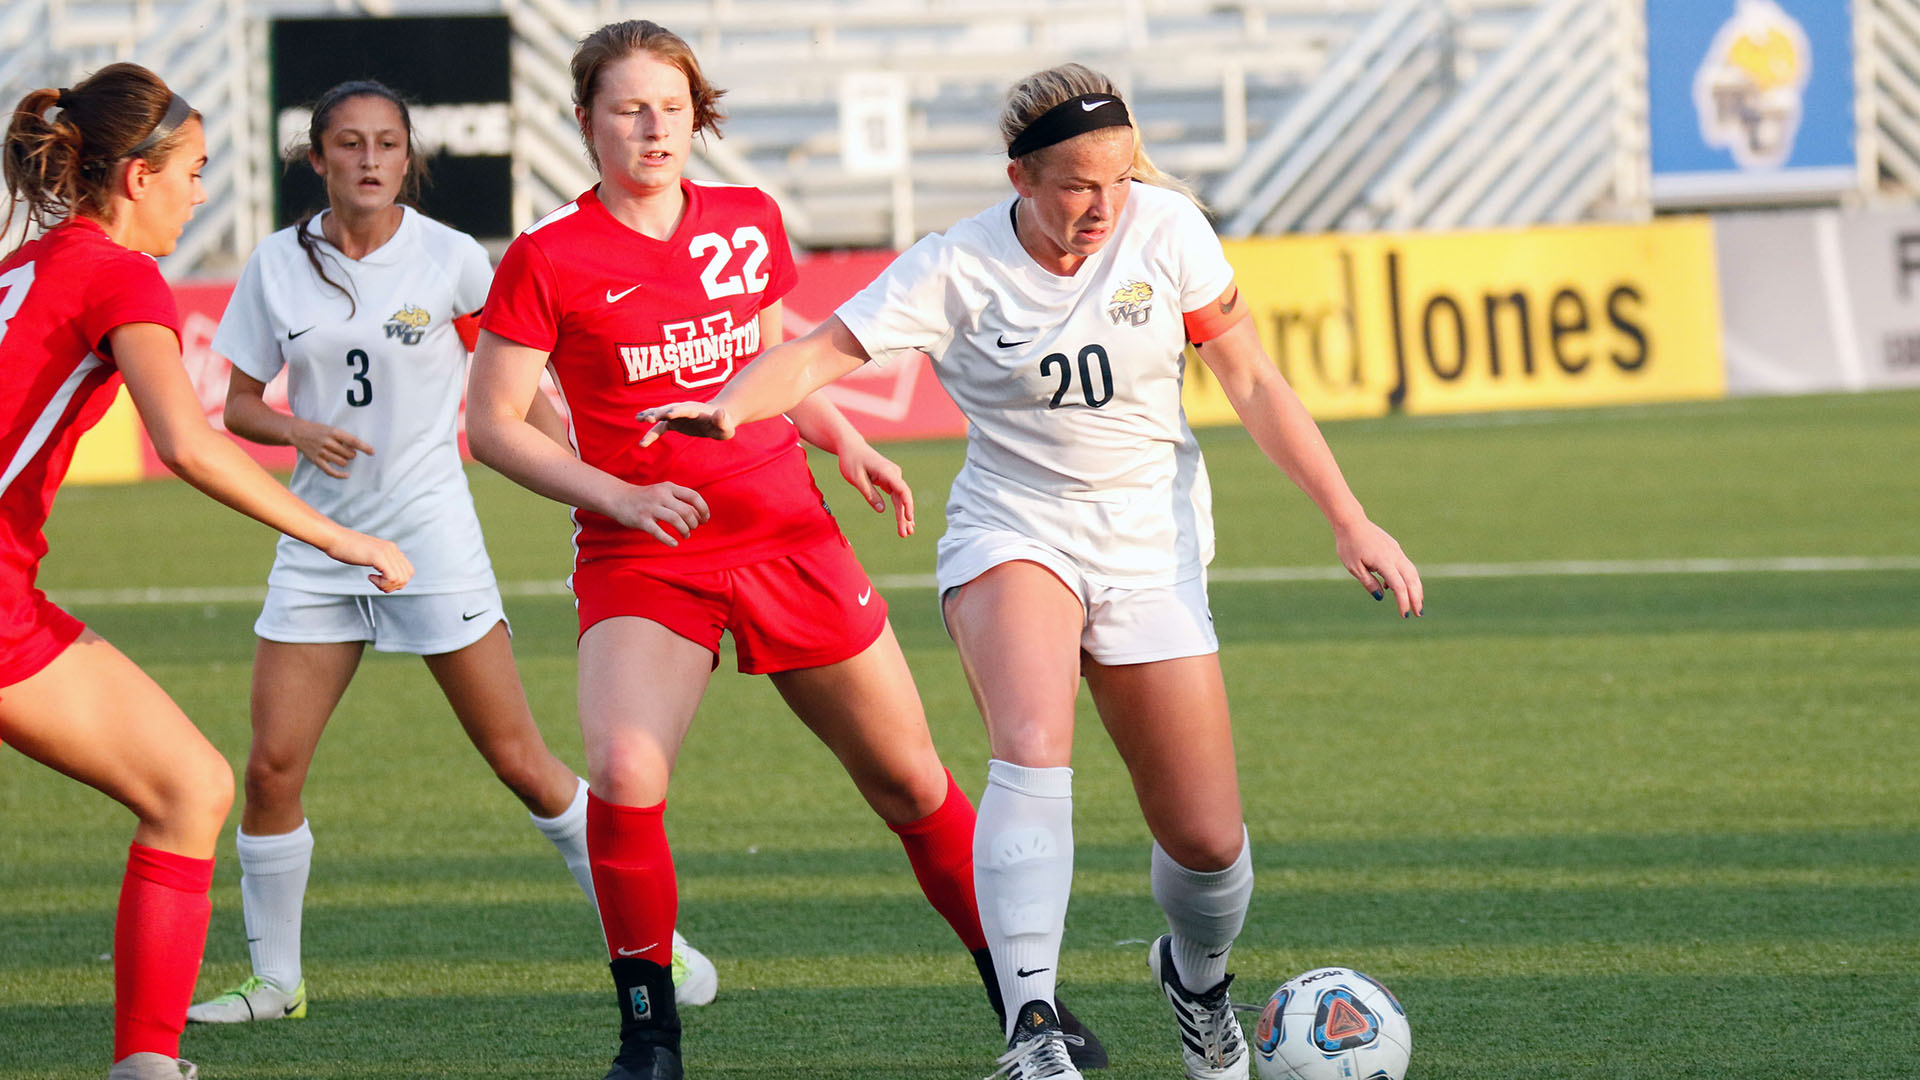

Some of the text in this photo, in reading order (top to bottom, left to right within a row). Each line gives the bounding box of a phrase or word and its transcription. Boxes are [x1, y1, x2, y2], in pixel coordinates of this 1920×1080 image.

[688, 226, 769, 300] 22
[383, 322, 425, 346] WU
[1106, 303, 1152, 328] WU
[1387, 251, 1651, 412] Jones
[346, 348, 373, 407] 3
[620, 313, 760, 382] WASHINGTON
[1040, 344, 1113, 409] 20
[1300, 970, 1344, 987] NCAA
